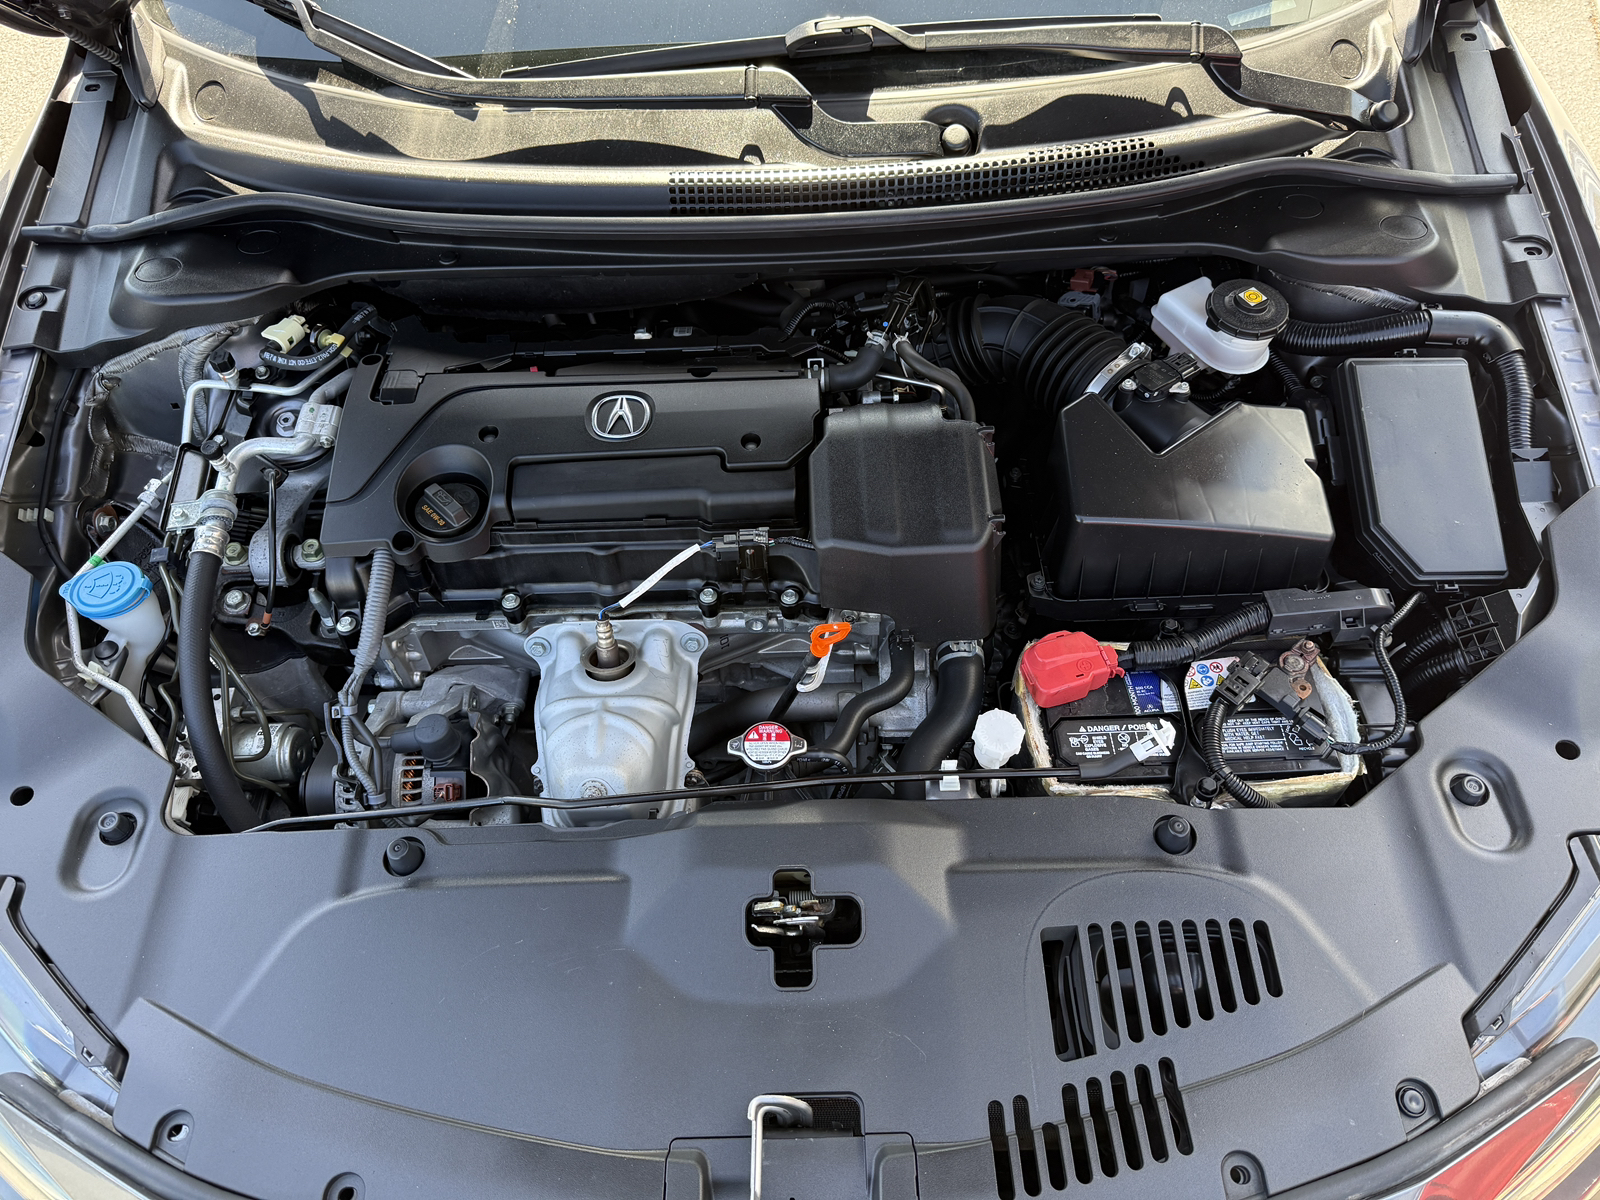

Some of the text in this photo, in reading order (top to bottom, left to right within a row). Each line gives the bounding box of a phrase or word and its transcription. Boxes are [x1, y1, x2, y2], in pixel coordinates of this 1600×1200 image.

[421, 504, 434, 515] SAE
[1127, 685, 1139, 706] MONTH
[1087, 724, 1120, 732] DANGER
[1127, 723, 1158, 731] POISN
